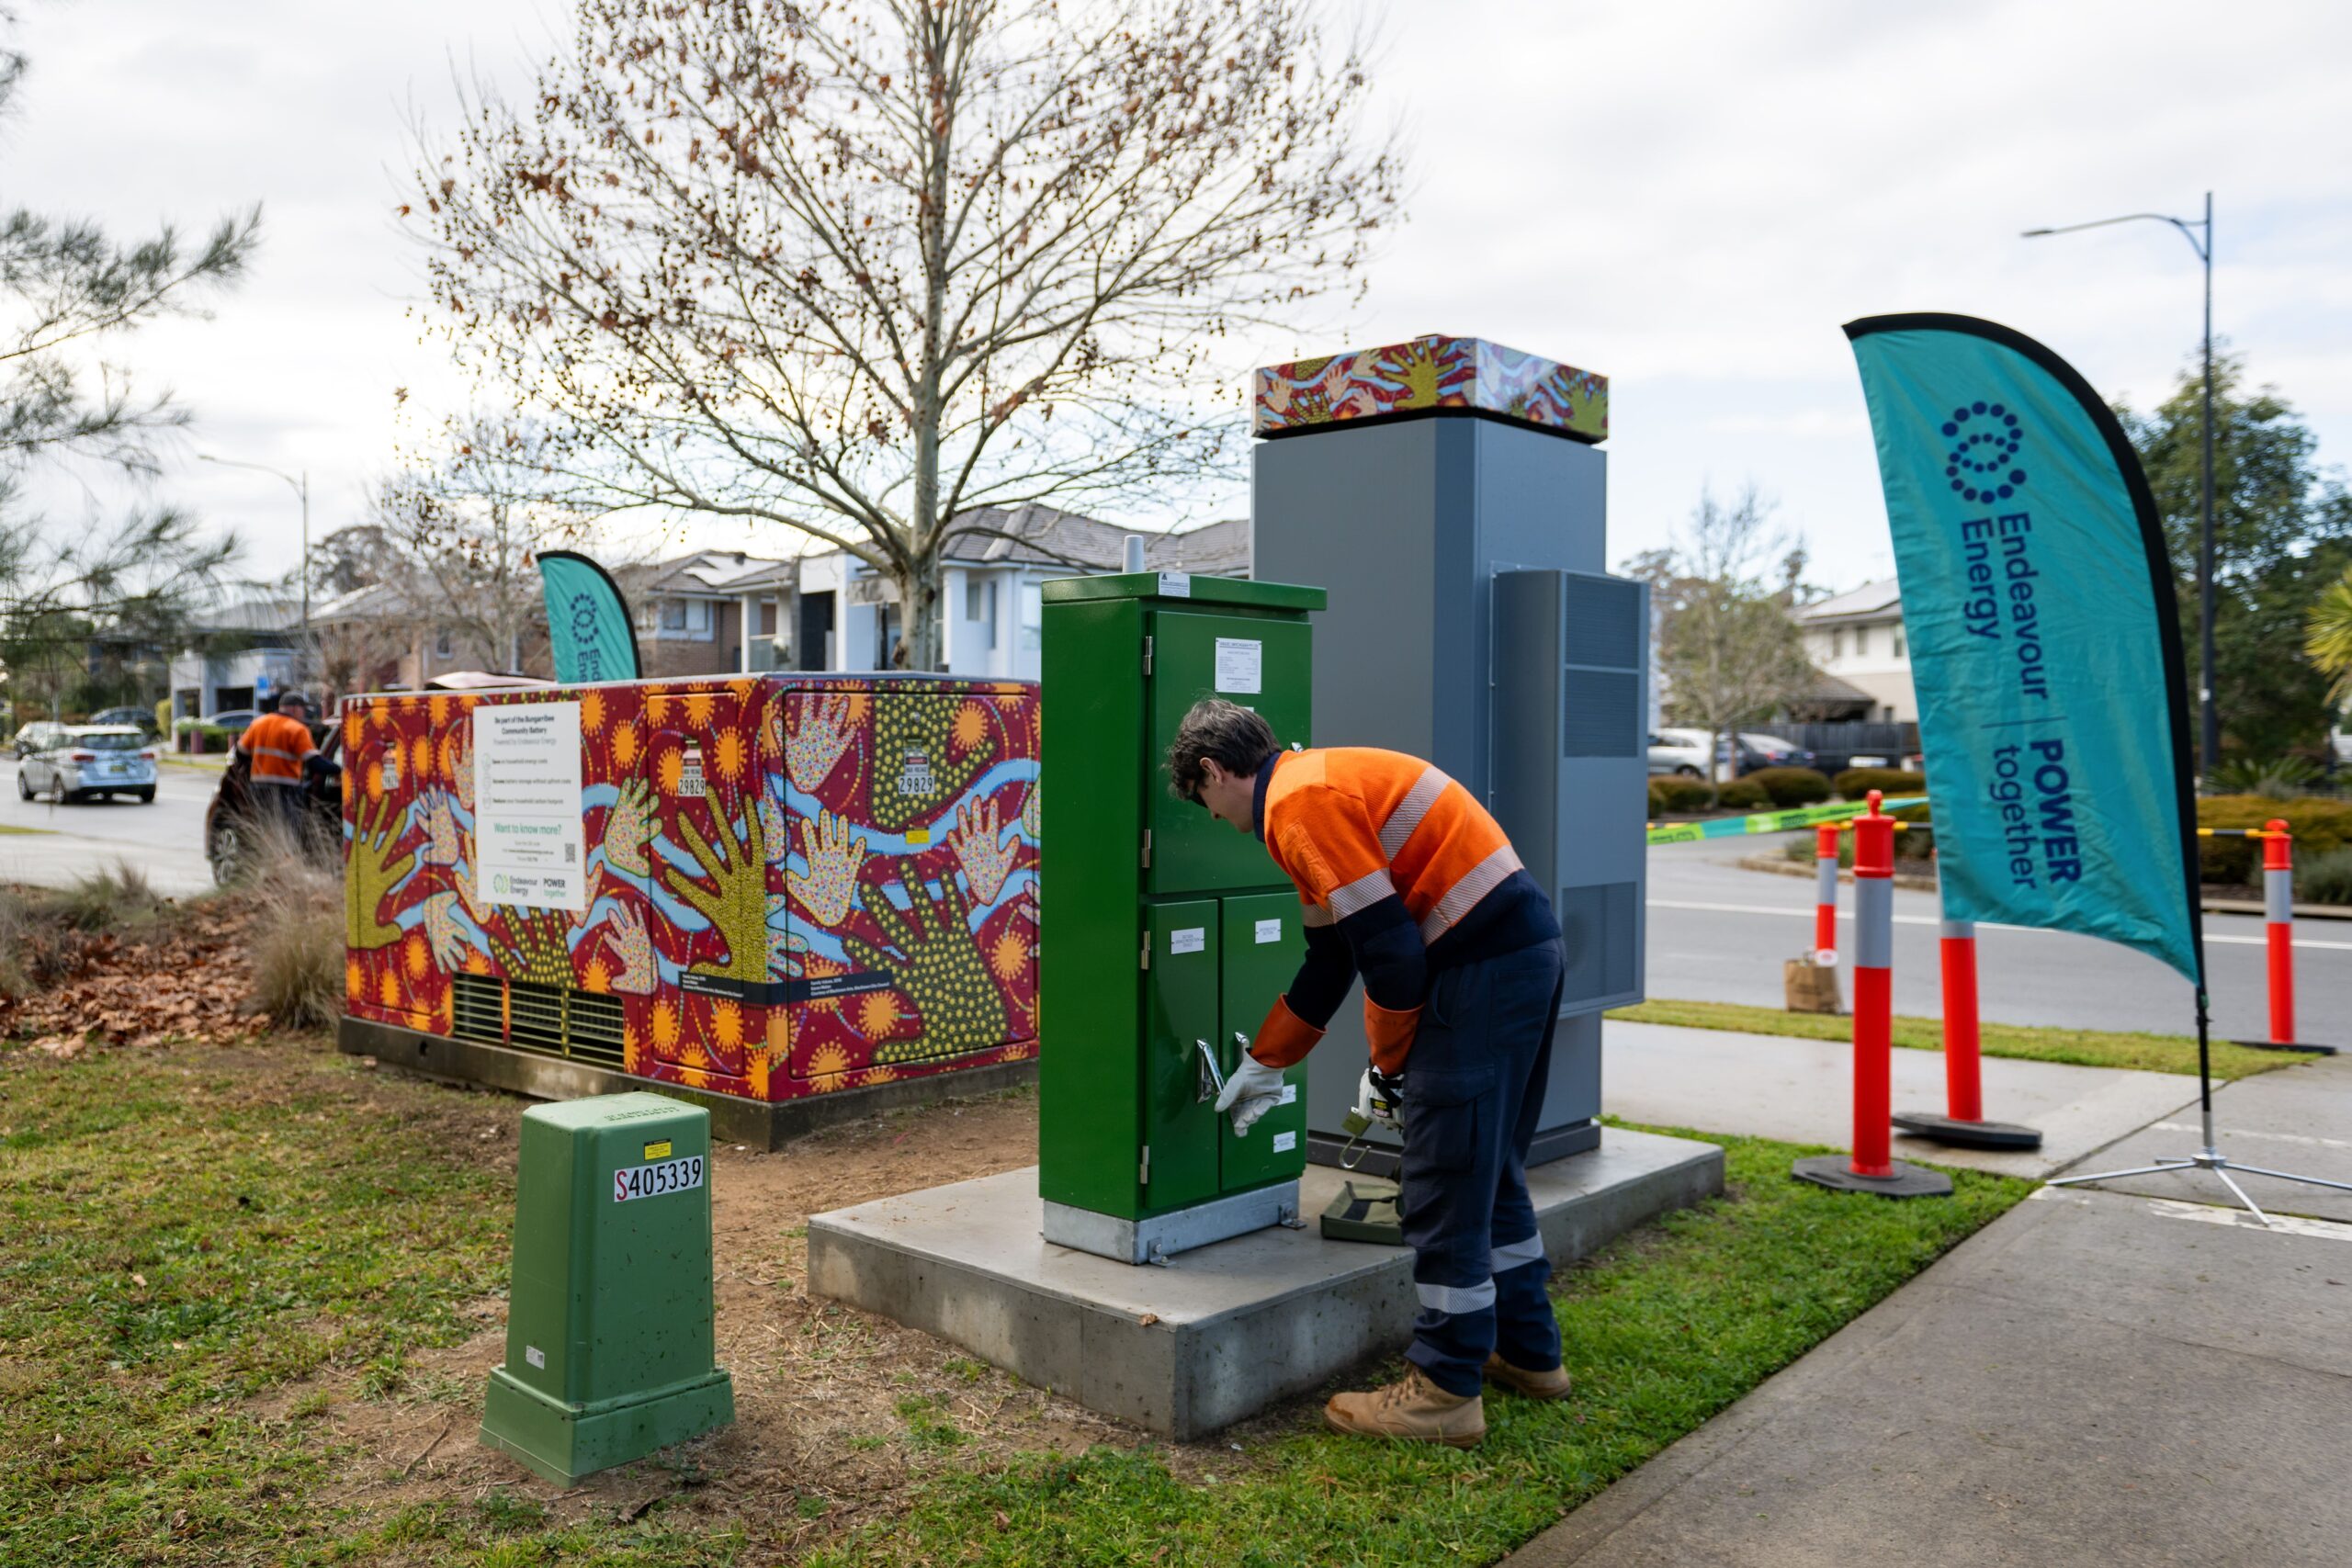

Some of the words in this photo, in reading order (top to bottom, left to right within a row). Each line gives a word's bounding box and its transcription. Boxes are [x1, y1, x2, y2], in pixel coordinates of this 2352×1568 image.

[1961, 517, 2001, 640] Energy
[1999, 513, 2049, 699] Endeavour
[502, 727, 528, 735] Community
[528, 727, 547, 735] Battery
[679, 779, 705, 795] 29829
[899, 777, 933, 793] 29829
[1990, 744, 2038, 891] together
[2030, 739, 2082, 884] POWER
[493, 822, 511, 833] Want
[512, 824, 519, 833] to
[519, 822, 538, 834] know
[539, 823, 561, 835] more?
[509, 874, 537, 886] Endeavour
[543, 877, 566, 888] POWER
[509, 886, 529, 897] Energy
[544, 888, 566, 899] together
[616, 1158, 701, 1201] S405339
